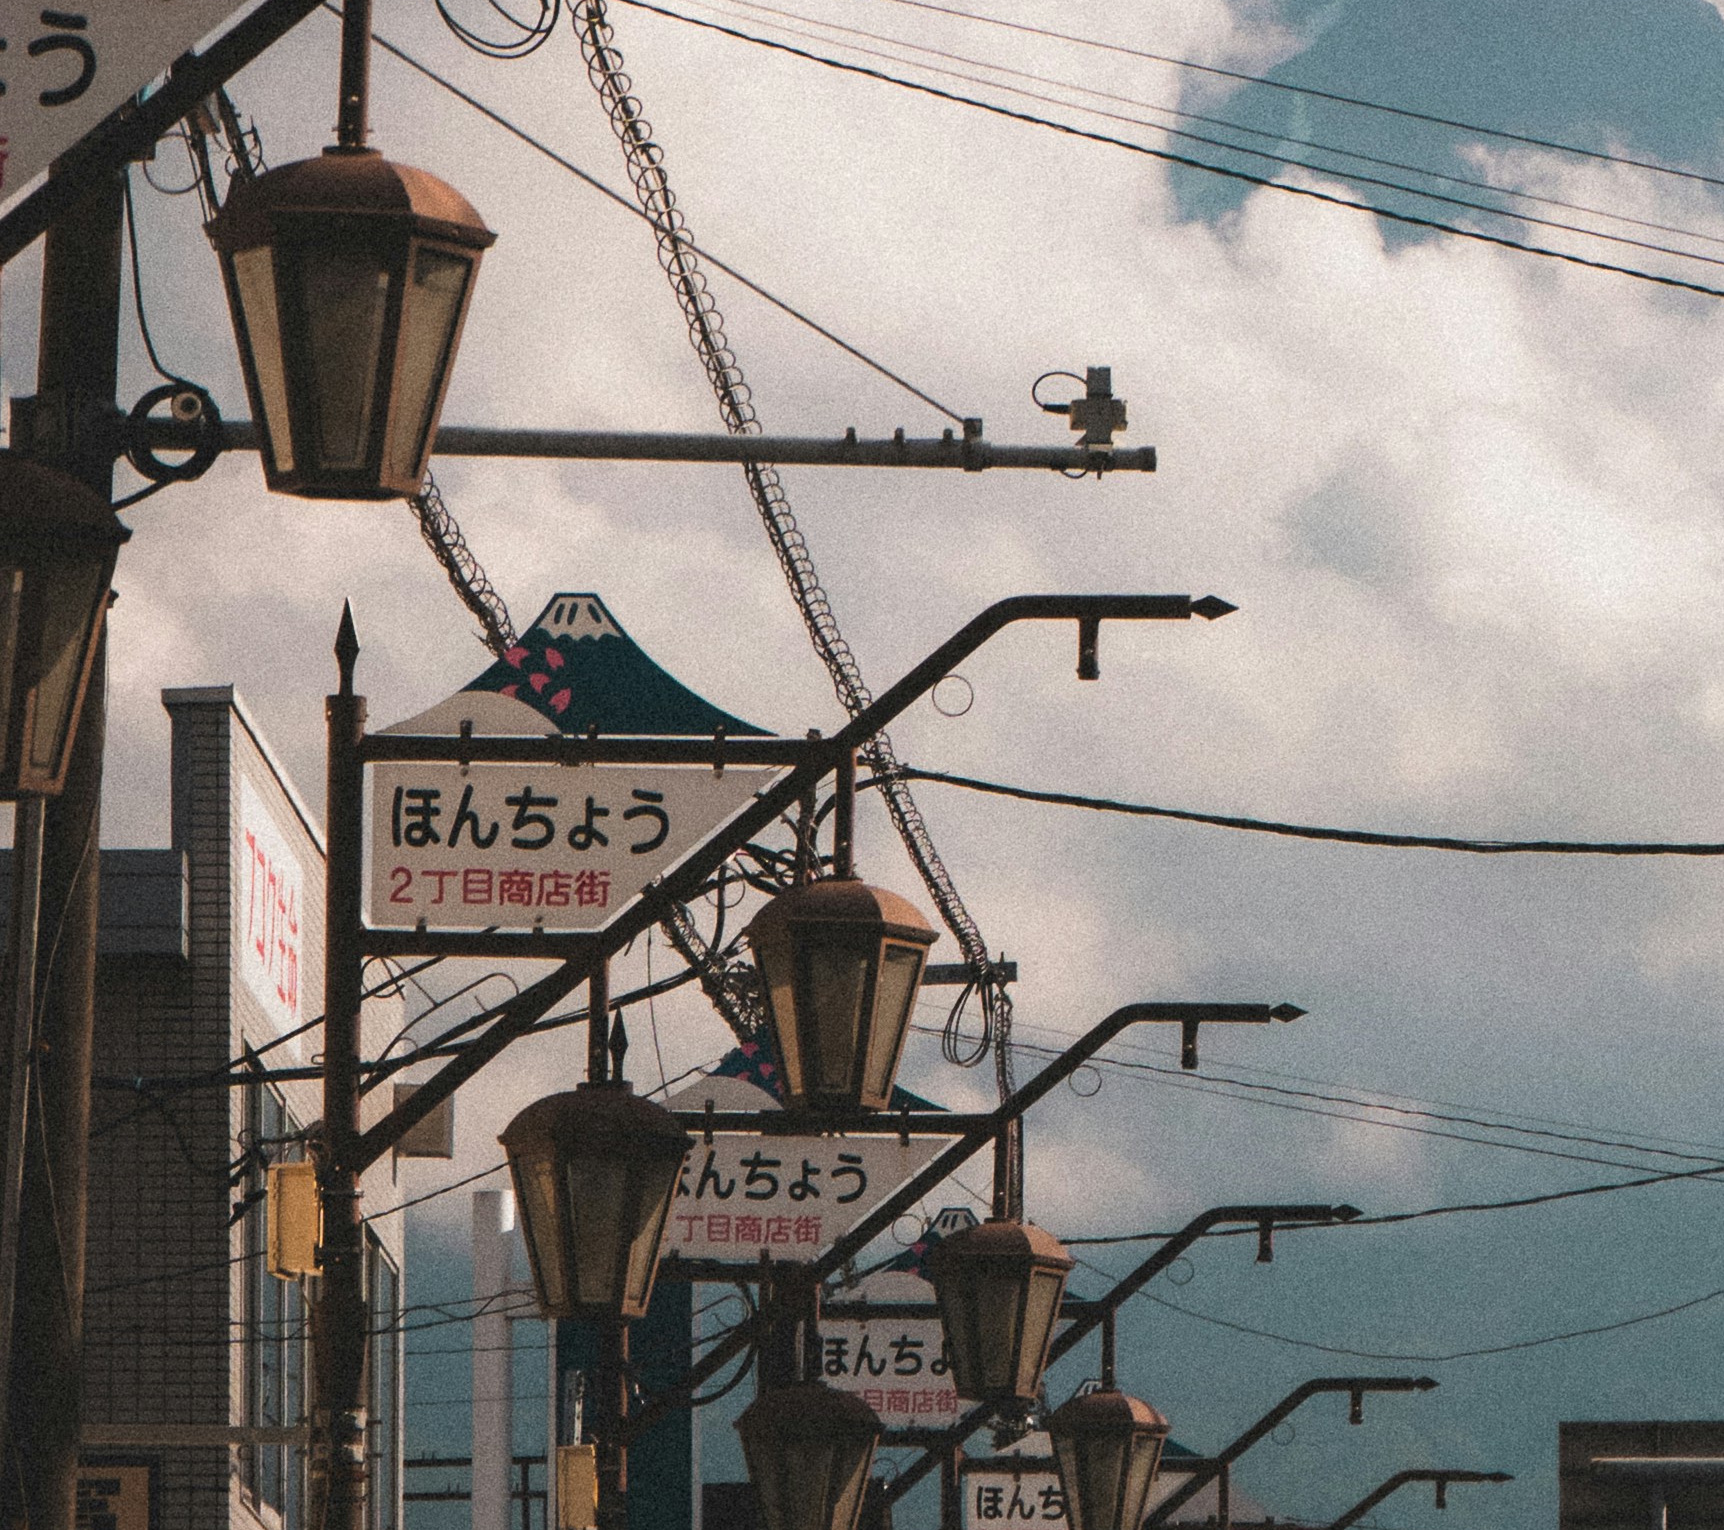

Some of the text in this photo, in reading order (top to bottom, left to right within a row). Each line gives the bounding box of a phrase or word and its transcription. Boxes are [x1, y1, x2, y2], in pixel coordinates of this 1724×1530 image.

[0, 9, 97, 107] う
[390, 784, 670, 856] ほんちょう
[389, 867, 610, 908] 2丁目商店街
[667, 1213, 823, 1245] 丁目商店街
[852, 1389, 958, 1414] 目商店街
